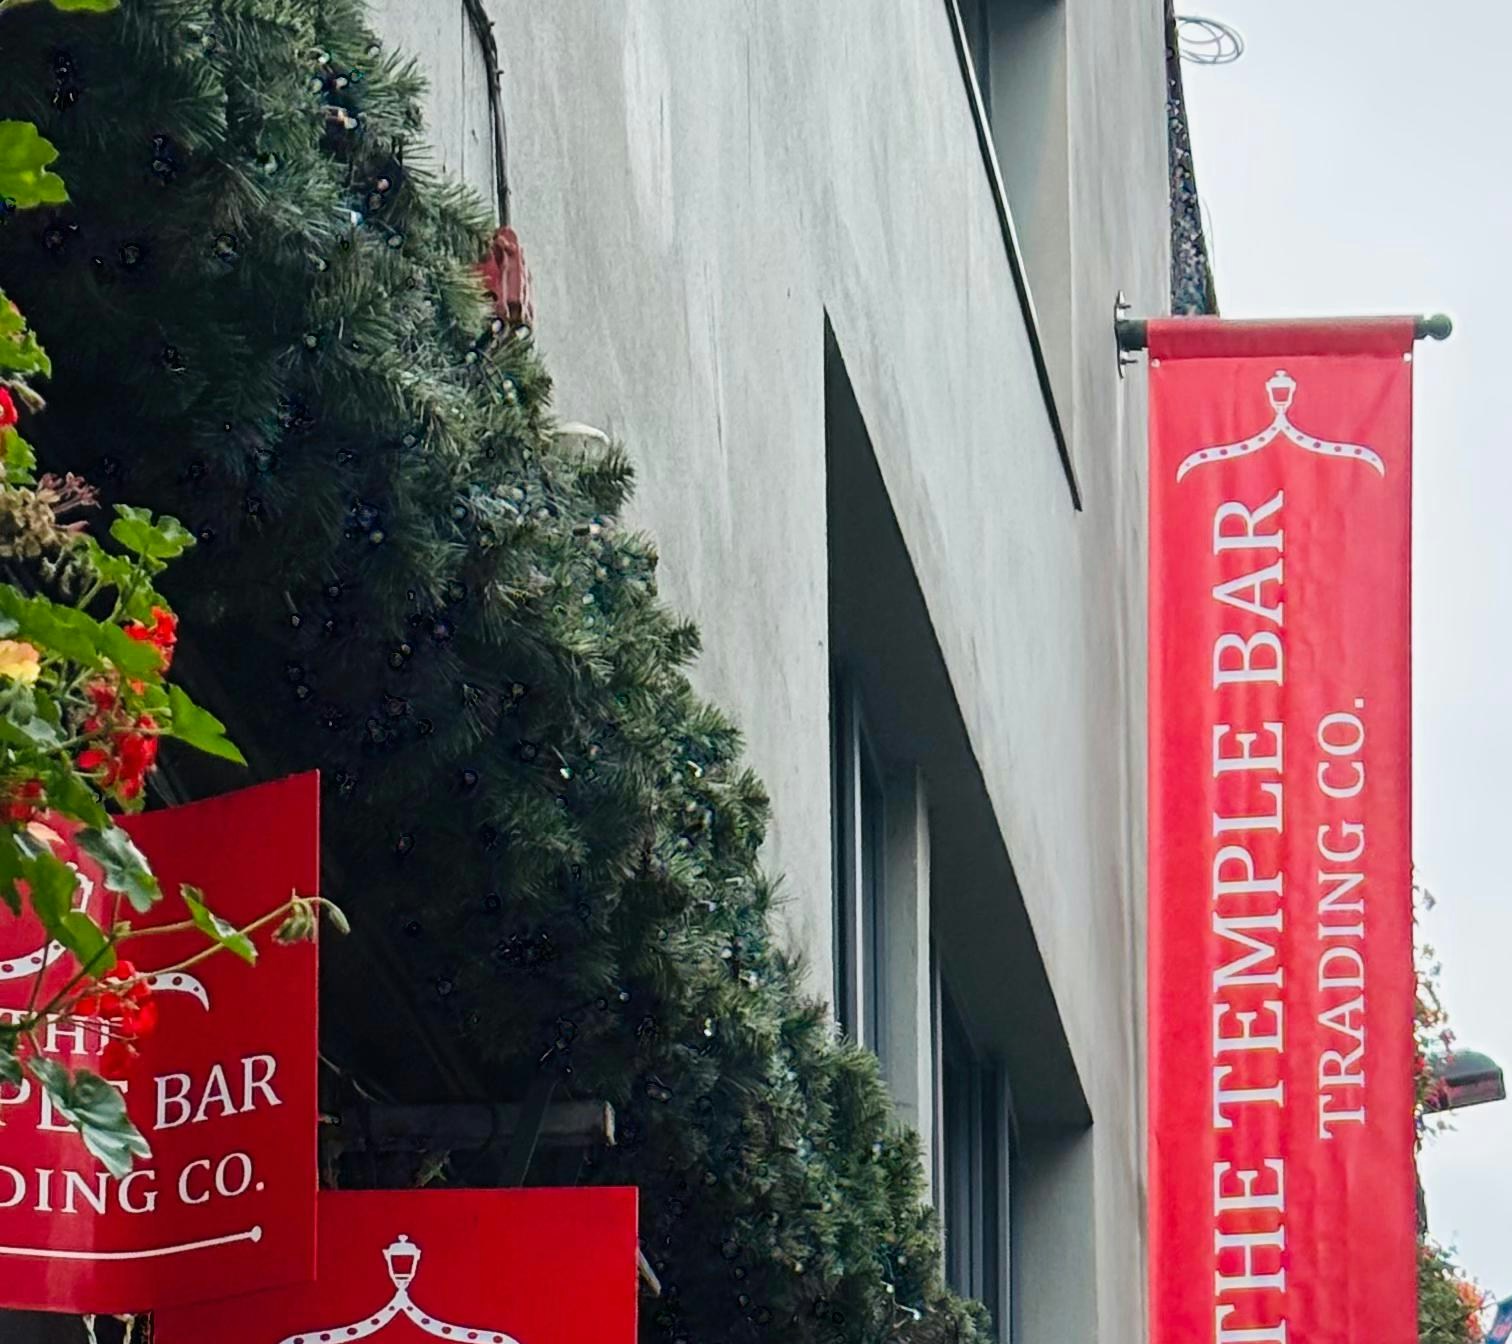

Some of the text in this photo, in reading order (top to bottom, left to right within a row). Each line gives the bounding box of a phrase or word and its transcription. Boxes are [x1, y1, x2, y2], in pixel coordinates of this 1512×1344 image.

[1211, 488, 1285, 690] BAR
[1211, 721, 1286, 1130] TEMPLE
[1316, 697, 1366, 1140] TRADING CO.
[153, 1054, 283, 1131] BAR
[178, 1152, 265, 1205] CO.
